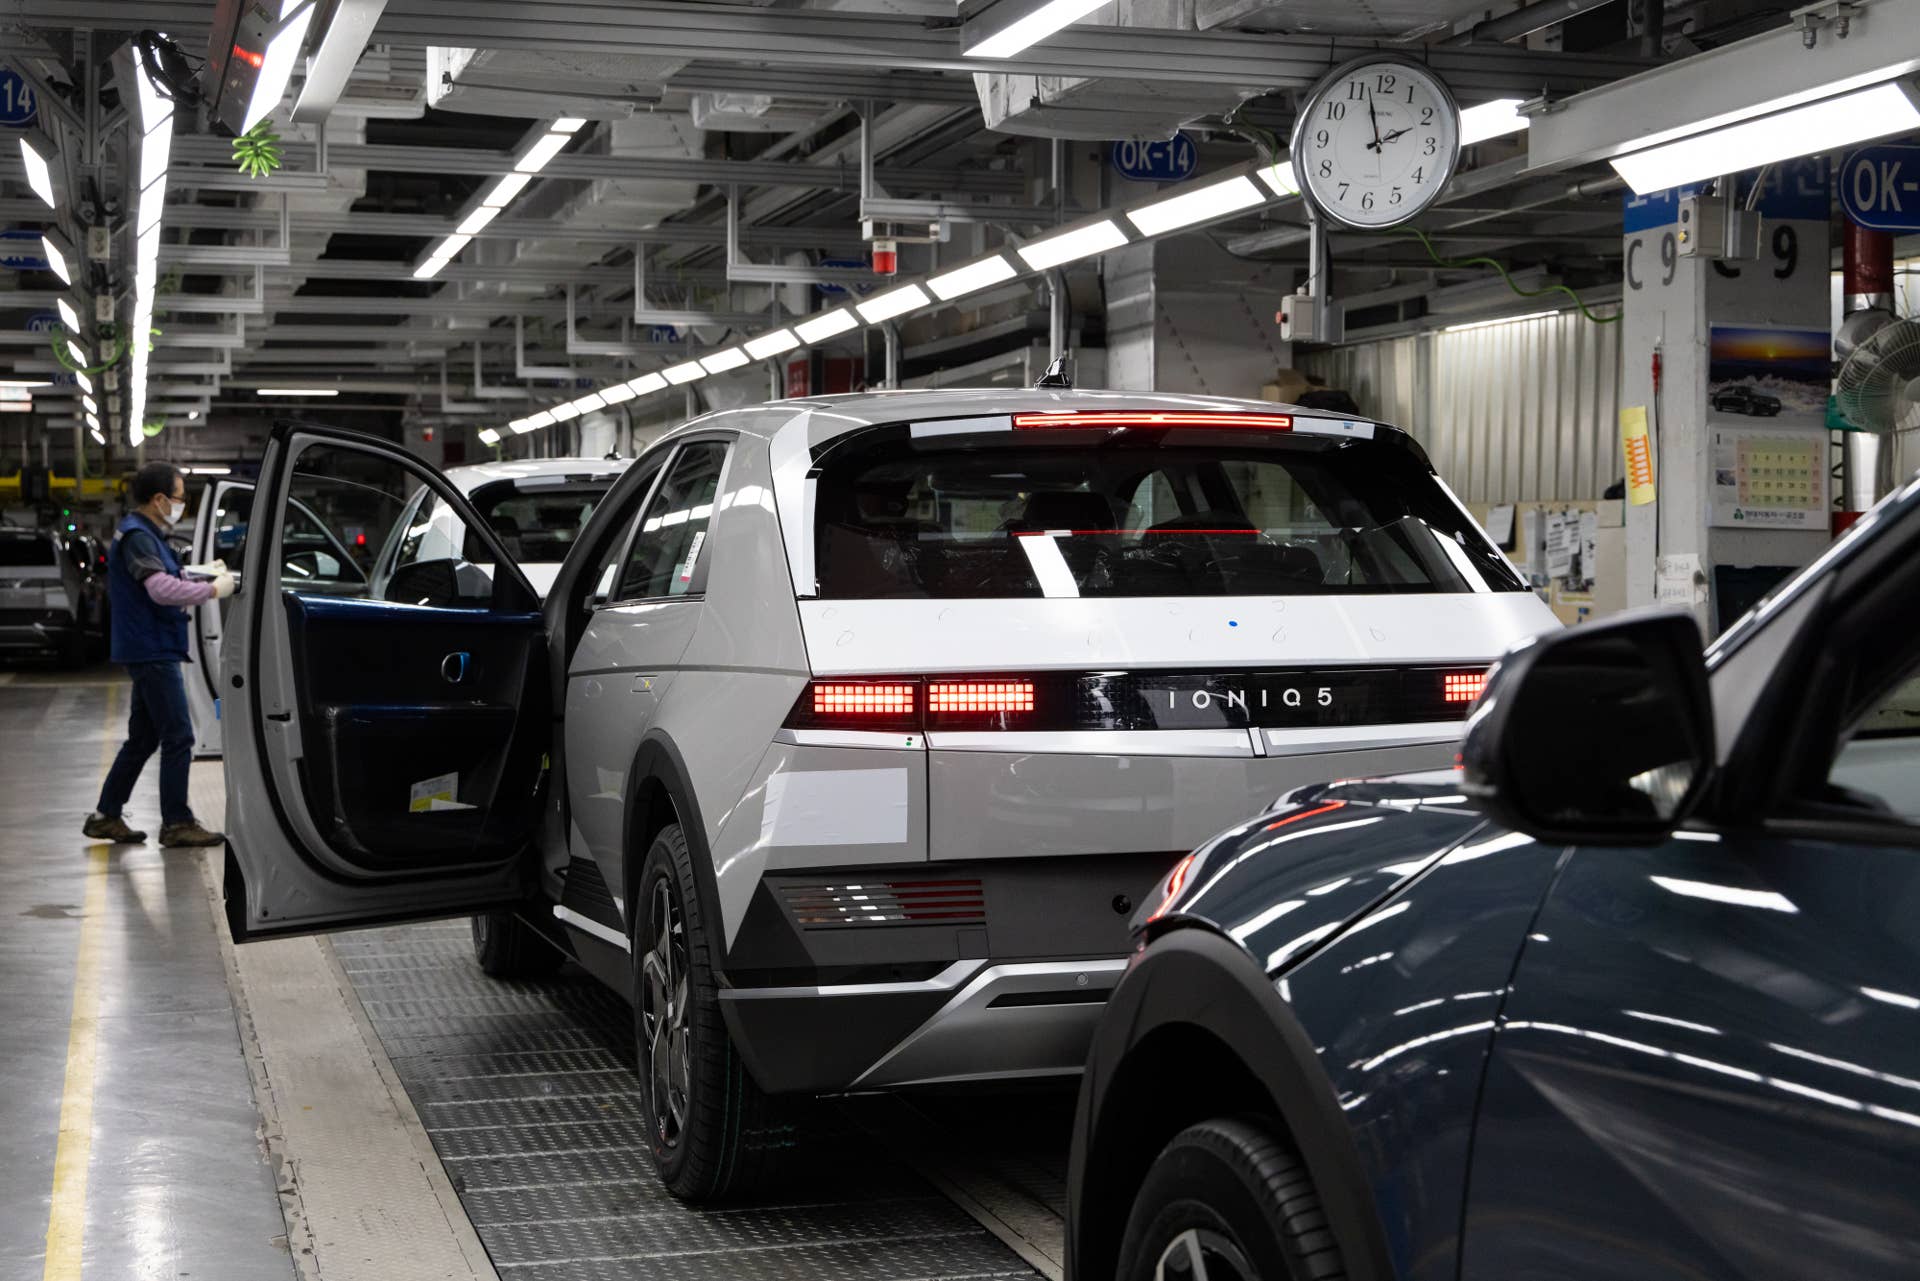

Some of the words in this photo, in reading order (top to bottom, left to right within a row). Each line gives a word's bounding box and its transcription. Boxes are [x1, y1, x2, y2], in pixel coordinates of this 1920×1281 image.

[1347, 81, 1365, 101] 11
[1375, 74, 1396, 94] 12
[3, 78, 31, 113] 14
[1405, 85, 1414, 104] 1
[1325, 101, 1346, 121] 10
[1420, 107, 1433, 126] 2
[1316, 130, 1329, 149] 9
[1423, 137, 1436, 156] 3
[1121, 140, 1189, 172] OK-14
[1319, 159, 1332, 178] 8
[1411, 166, 1424, 184] 4
[1337, 182, 1350, 201] 7
[1361, 191, 1374, 210] 6
[1389, 186, 1402, 205] 5
[1661, 231, 1676, 287] 9
[1772, 225, 1798, 279] 9
[1169, 688, 1301, 709] IONIQ
[1317, 687, 1333, 706] 5
